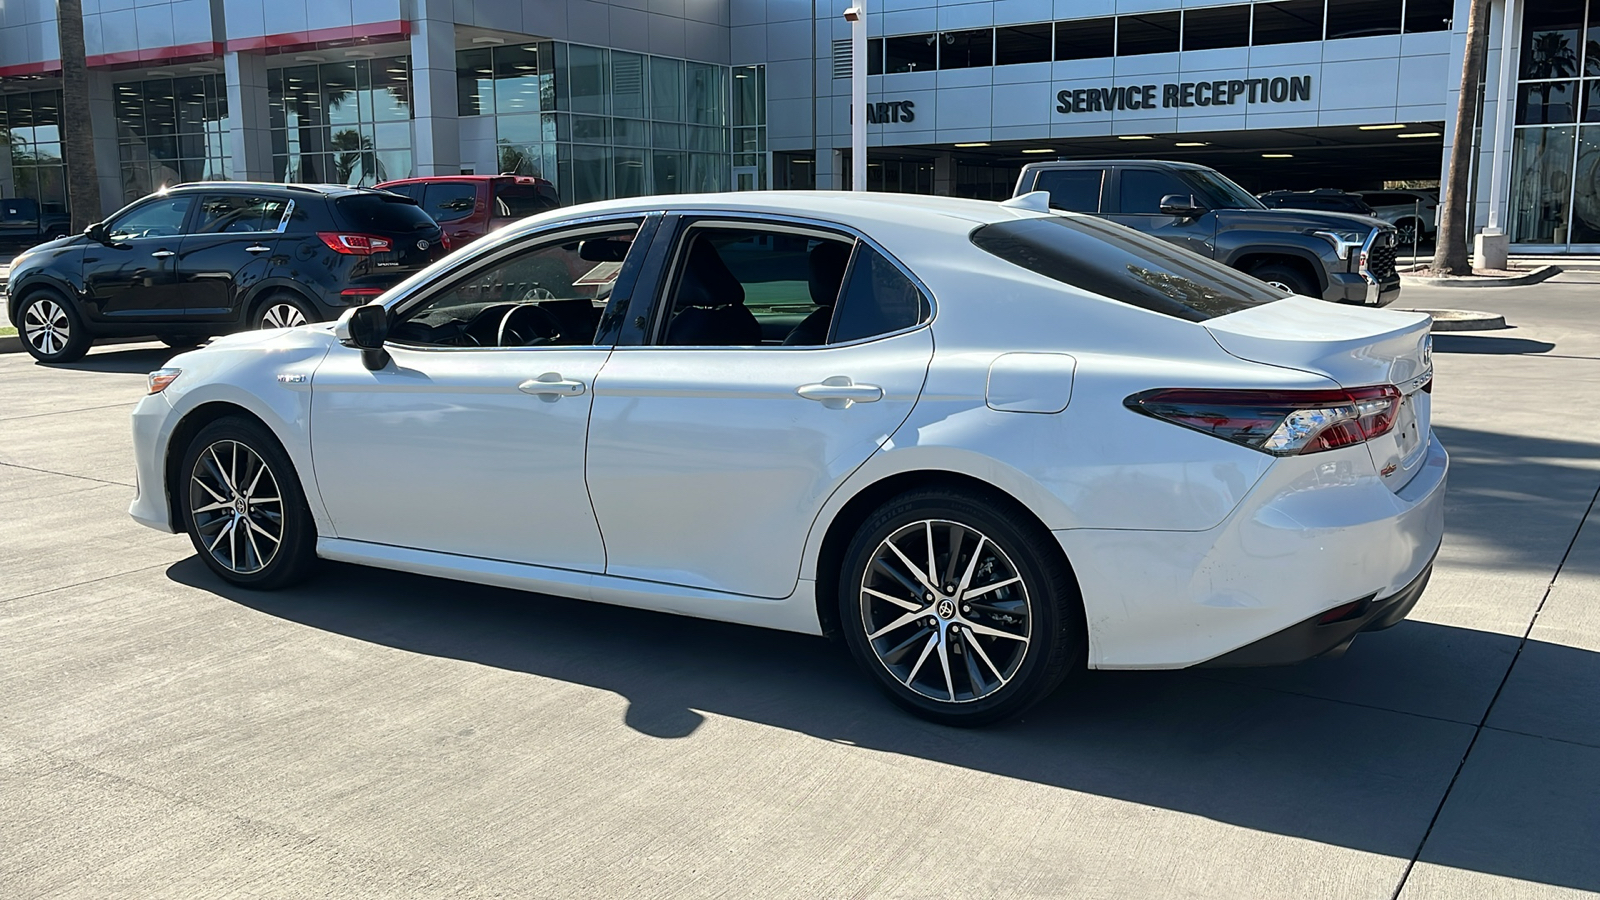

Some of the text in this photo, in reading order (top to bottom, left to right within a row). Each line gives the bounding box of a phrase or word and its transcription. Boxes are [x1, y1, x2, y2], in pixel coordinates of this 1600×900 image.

[1056, 75, 1312, 114] SERVICE RECEPTION
[850, 100, 915, 125] ARTS
